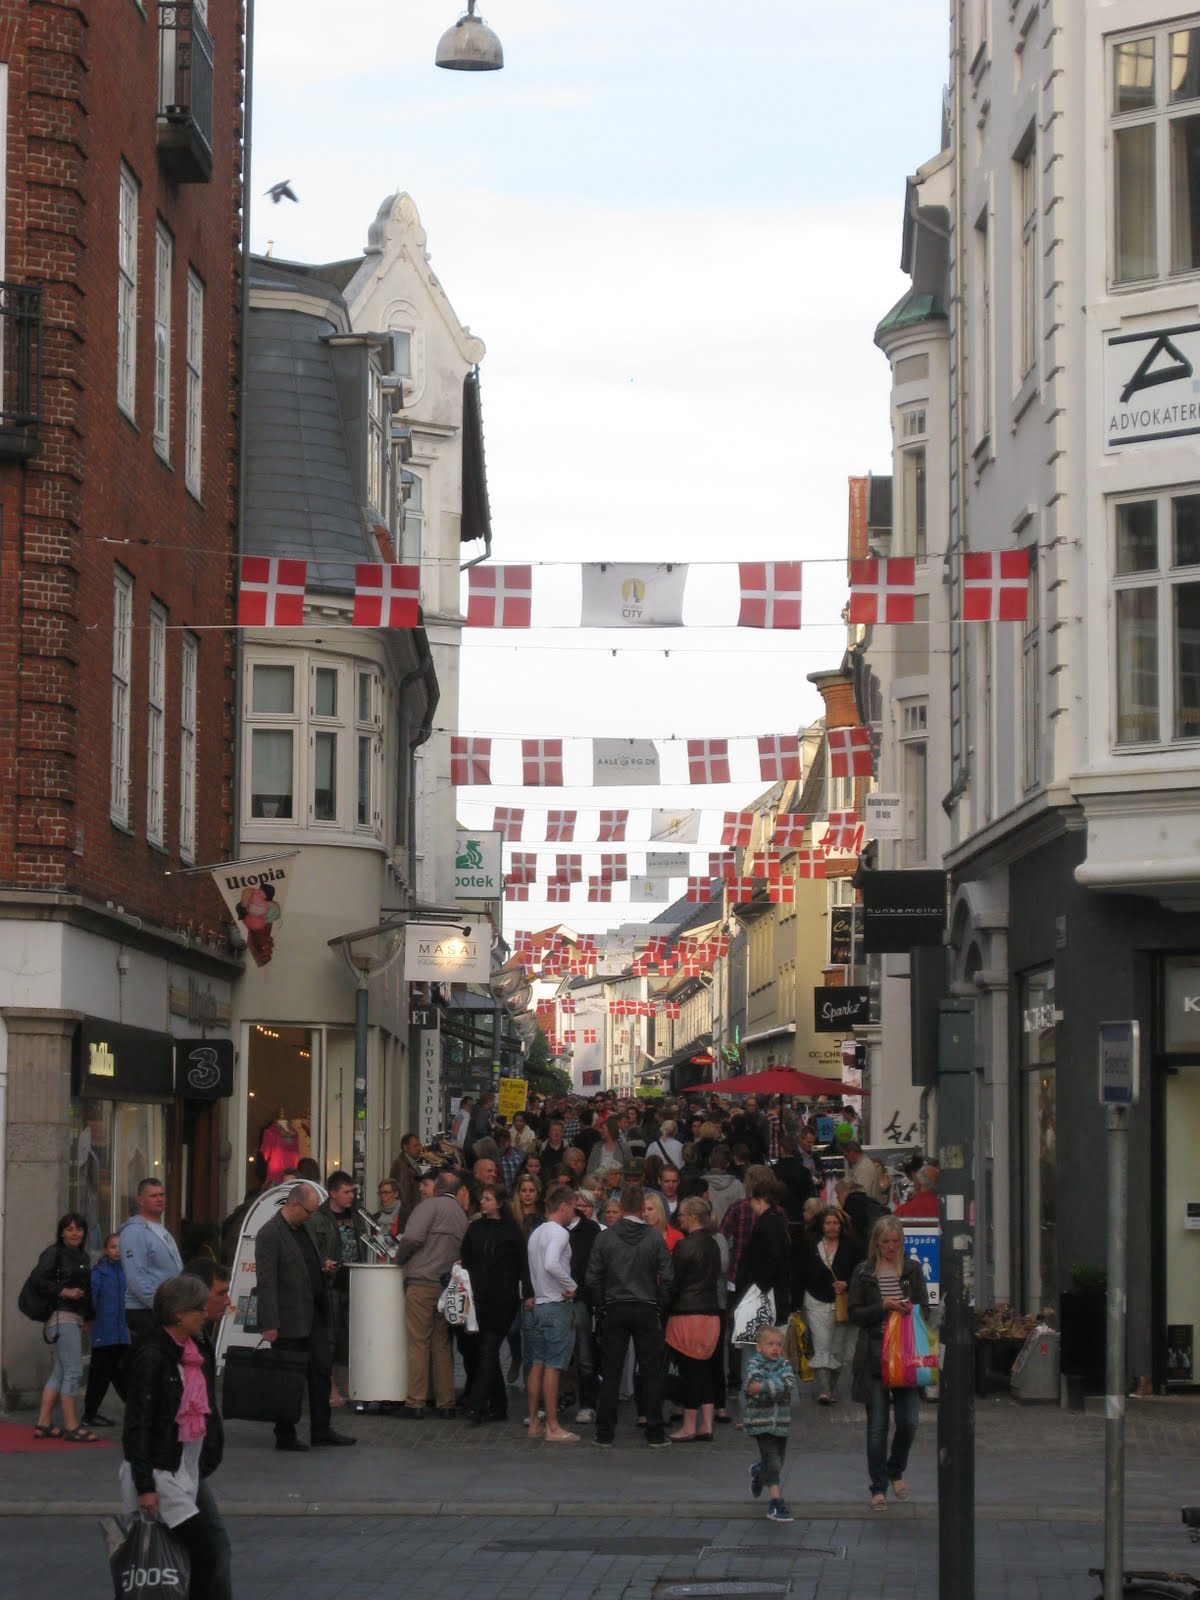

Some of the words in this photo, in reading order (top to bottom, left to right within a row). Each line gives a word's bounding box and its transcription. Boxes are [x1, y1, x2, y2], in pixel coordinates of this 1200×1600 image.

[1109, 402, 1200, 431] ADVOKATER
[622, 609, 643, 618] CITY
[225, 868, 286, 890] Utopia
[822, 1001, 861, 1022] Sparkz
[188, 1047, 221, 1089] 3
[903, 1236, 937, 1245] Gågade
[241, 1262, 256, 1273] TJE
